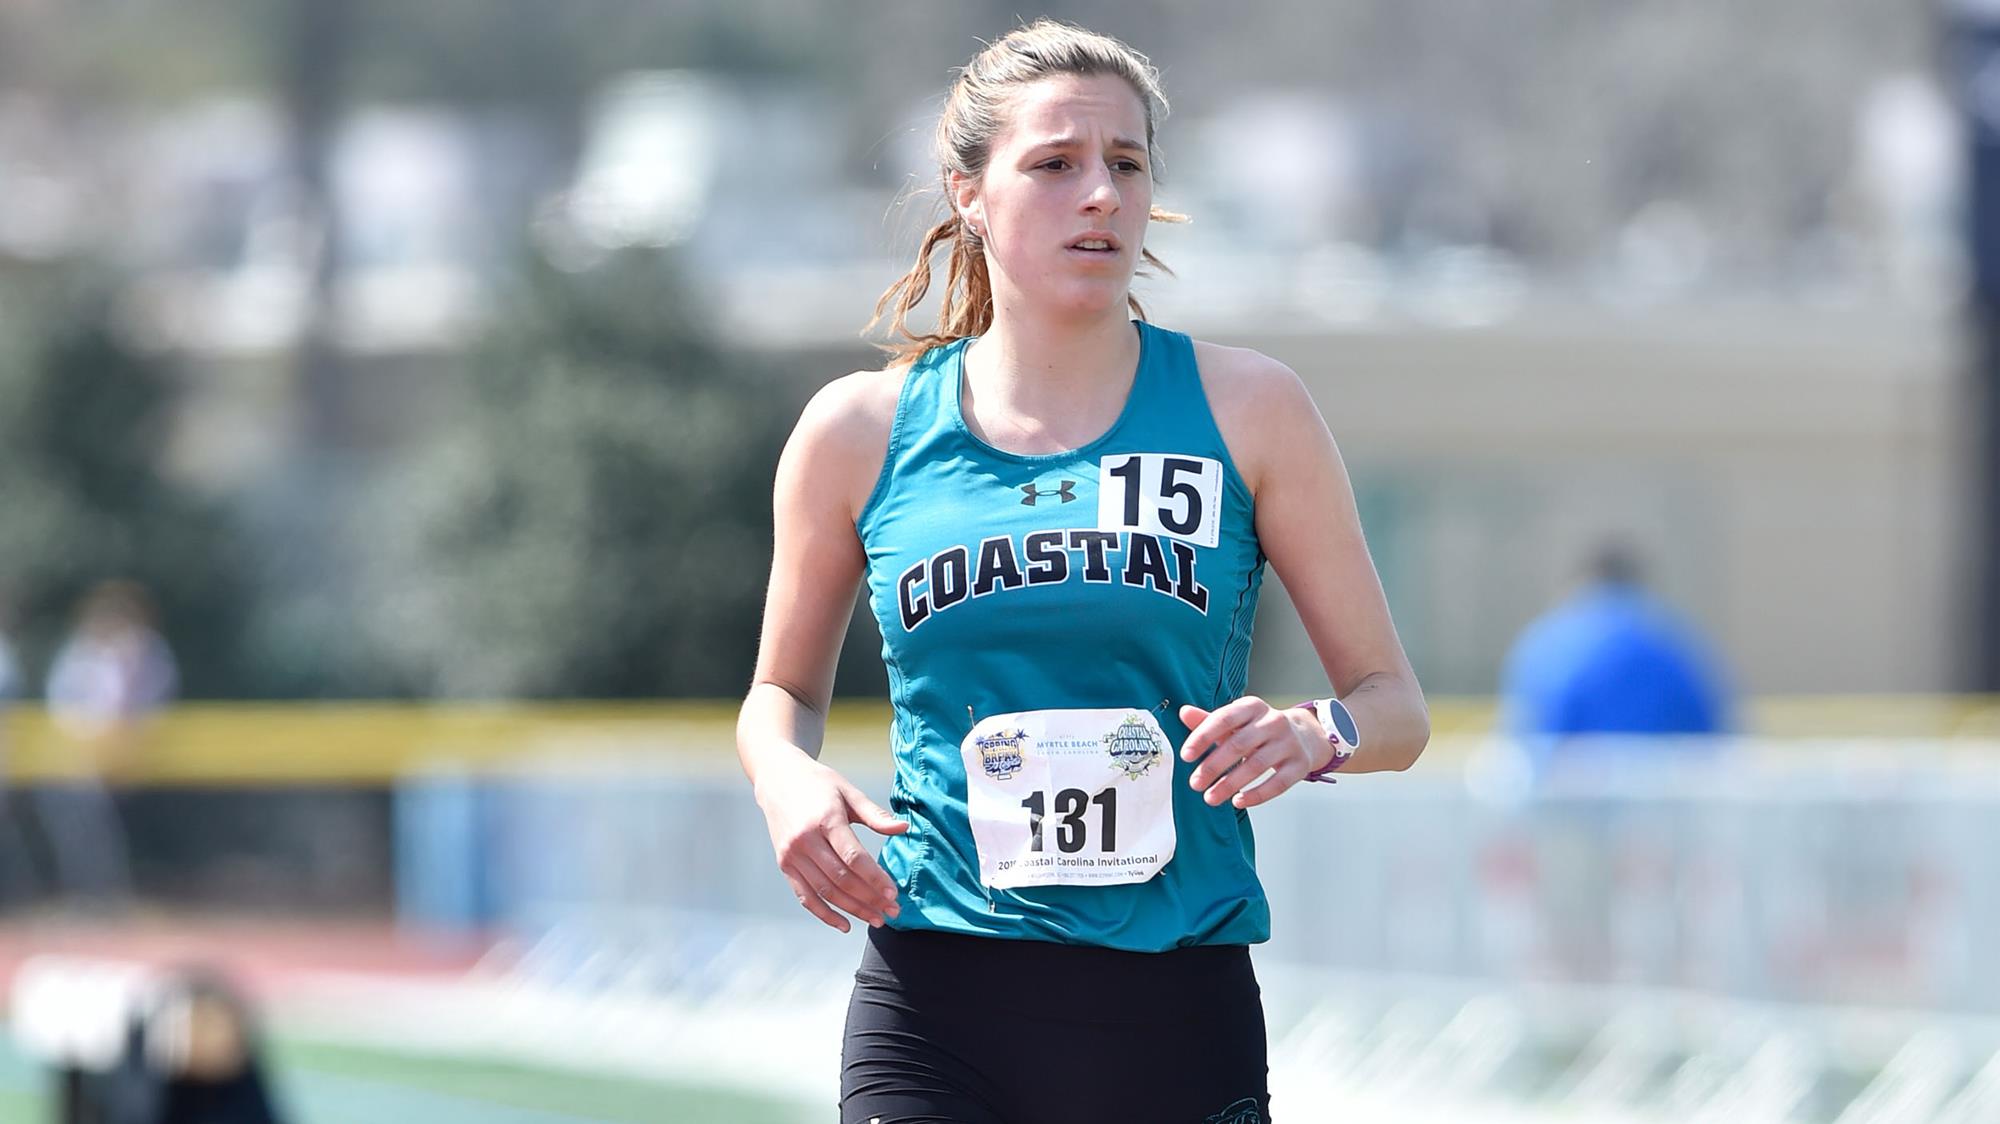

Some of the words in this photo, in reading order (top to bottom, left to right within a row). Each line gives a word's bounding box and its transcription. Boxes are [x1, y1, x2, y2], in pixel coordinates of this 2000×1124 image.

[1110, 455, 1203, 536] 15
[897, 527, 1210, 633] COASTAL
[1110, 739, 1158, 755] CAROLINA
[1118, 725, 1151, 739] COASTAL
[1021, 787, 1117, 853] 131
[1019, 857, 1054, 867] oastal
[1057, 857, 1095, 867] Carolina
[1097, 854, 1158, 867] Invitational
